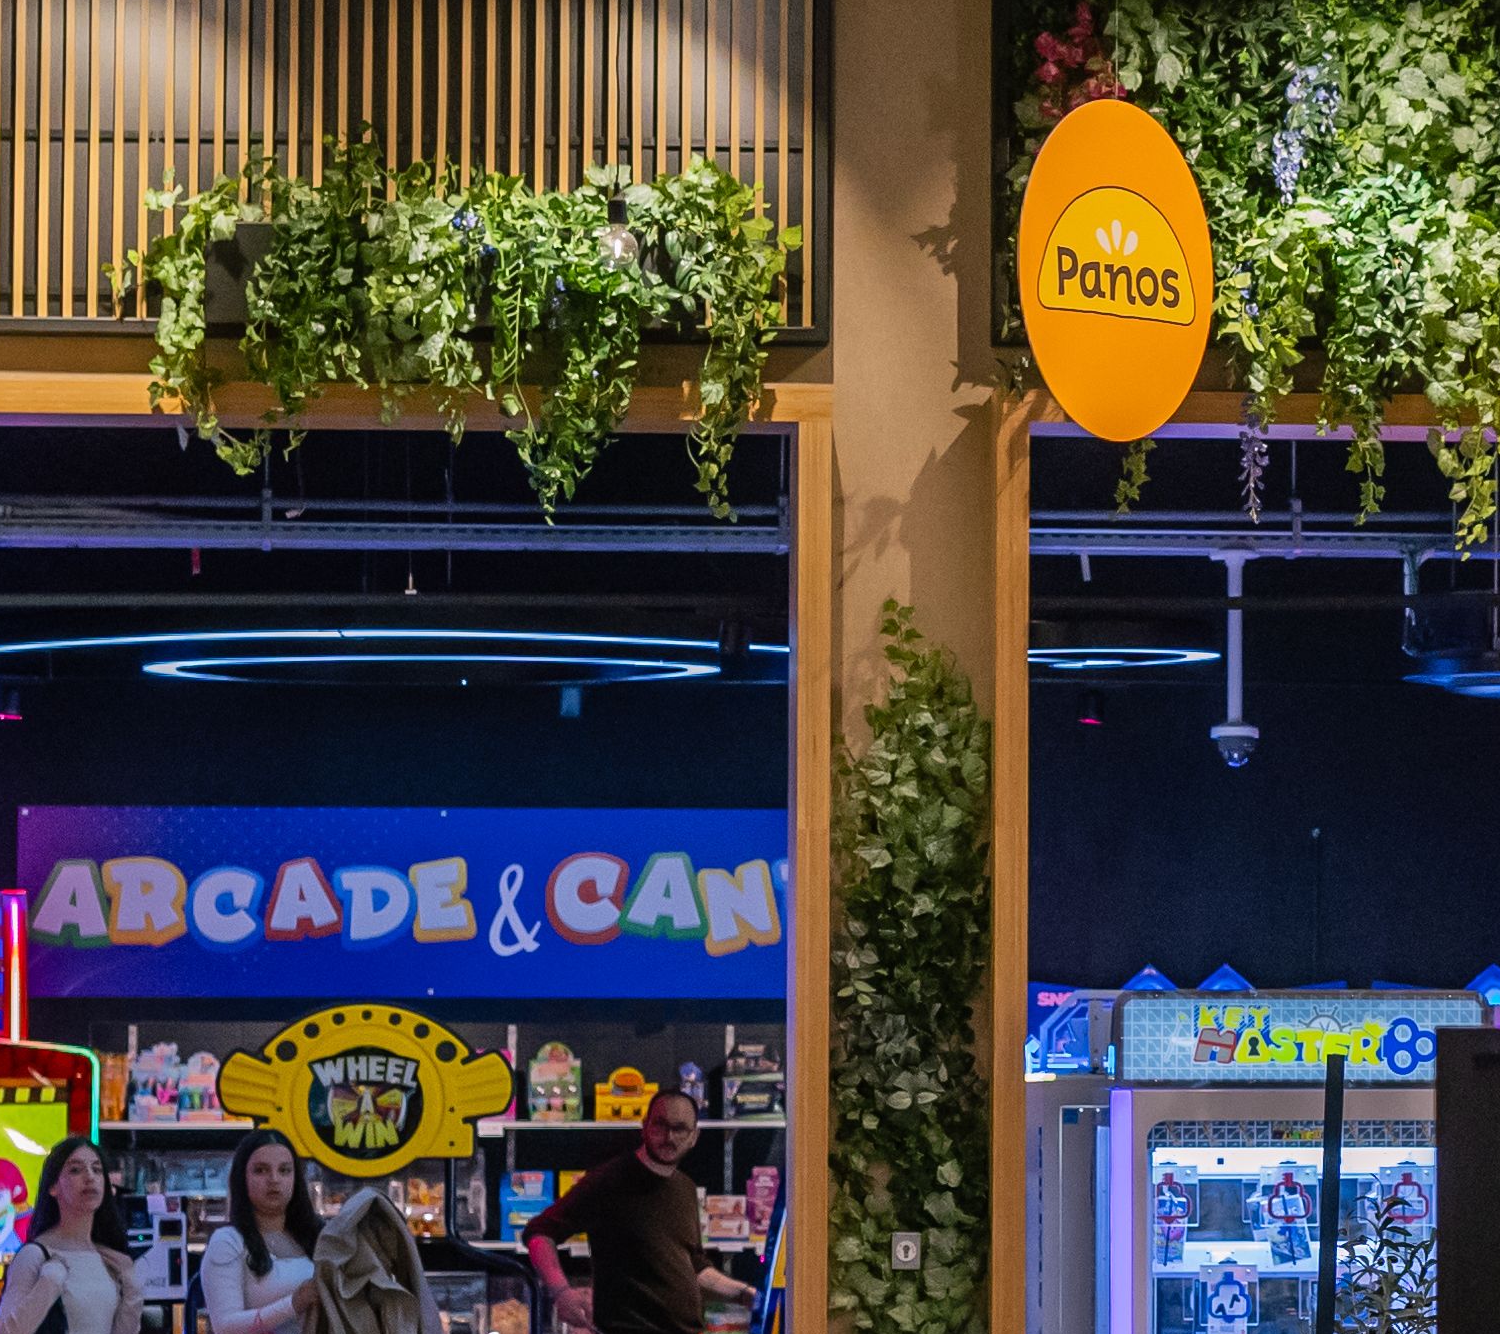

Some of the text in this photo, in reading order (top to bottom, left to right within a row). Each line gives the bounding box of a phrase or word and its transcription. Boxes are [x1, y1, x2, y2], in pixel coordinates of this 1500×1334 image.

[1056, 244, 1181, 309] Panos
[30, 851, 790, 957] ARCADE & CAN
[1194, 1004, 1270, 1030] KEY
[312, 1054, 420, 1089] WHEEL
[333, 1117, 400, 1149] WIN
